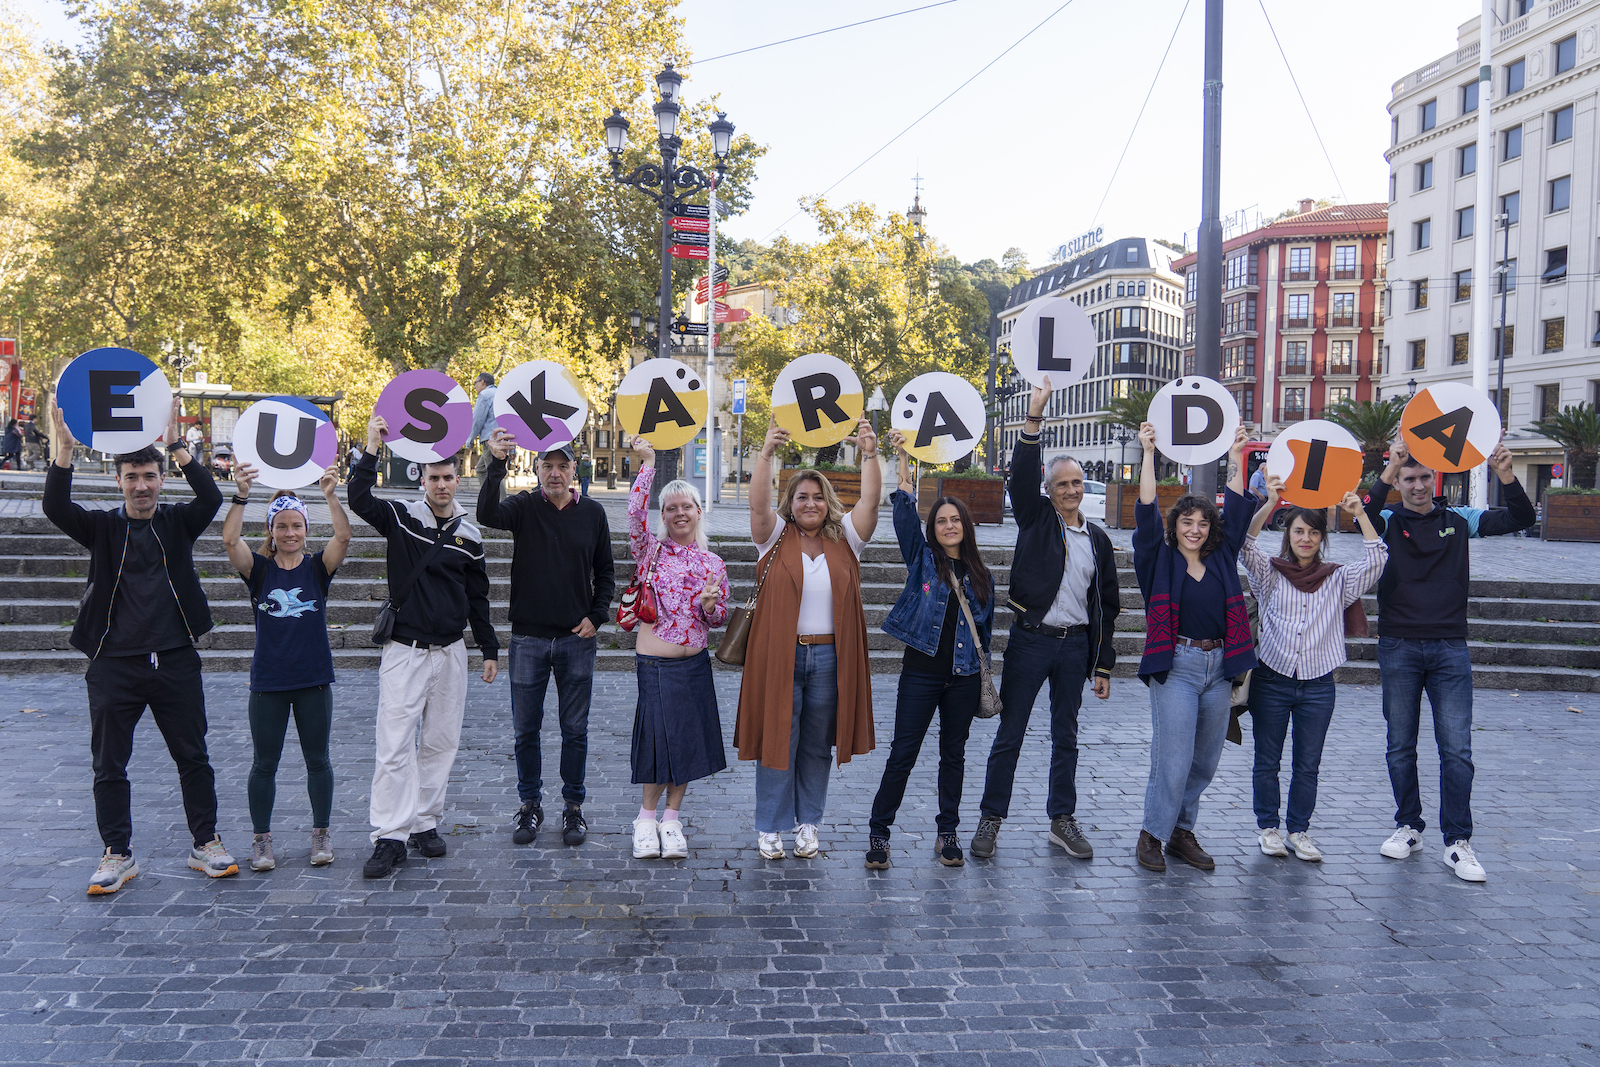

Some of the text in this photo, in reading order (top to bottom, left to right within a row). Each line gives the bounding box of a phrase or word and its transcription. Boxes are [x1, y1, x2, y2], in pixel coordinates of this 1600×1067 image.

[1067, 227, 1103, 256] surne
[1038, 317, 1072, 372] L
[89, 370, 143, 432] E
[400, 388, 449, 443] S
[507, 370, 579, 441] K
[638, 376, 696, 434] A
[792, 372, 850, 432] R
[914, 391, 974, 448] A
[1171, 394, 1224, 446] D
[256, 412, 317, 470] U
[1302, 438, 1328, 491] I
[1409, 406, 1474, 467] A
